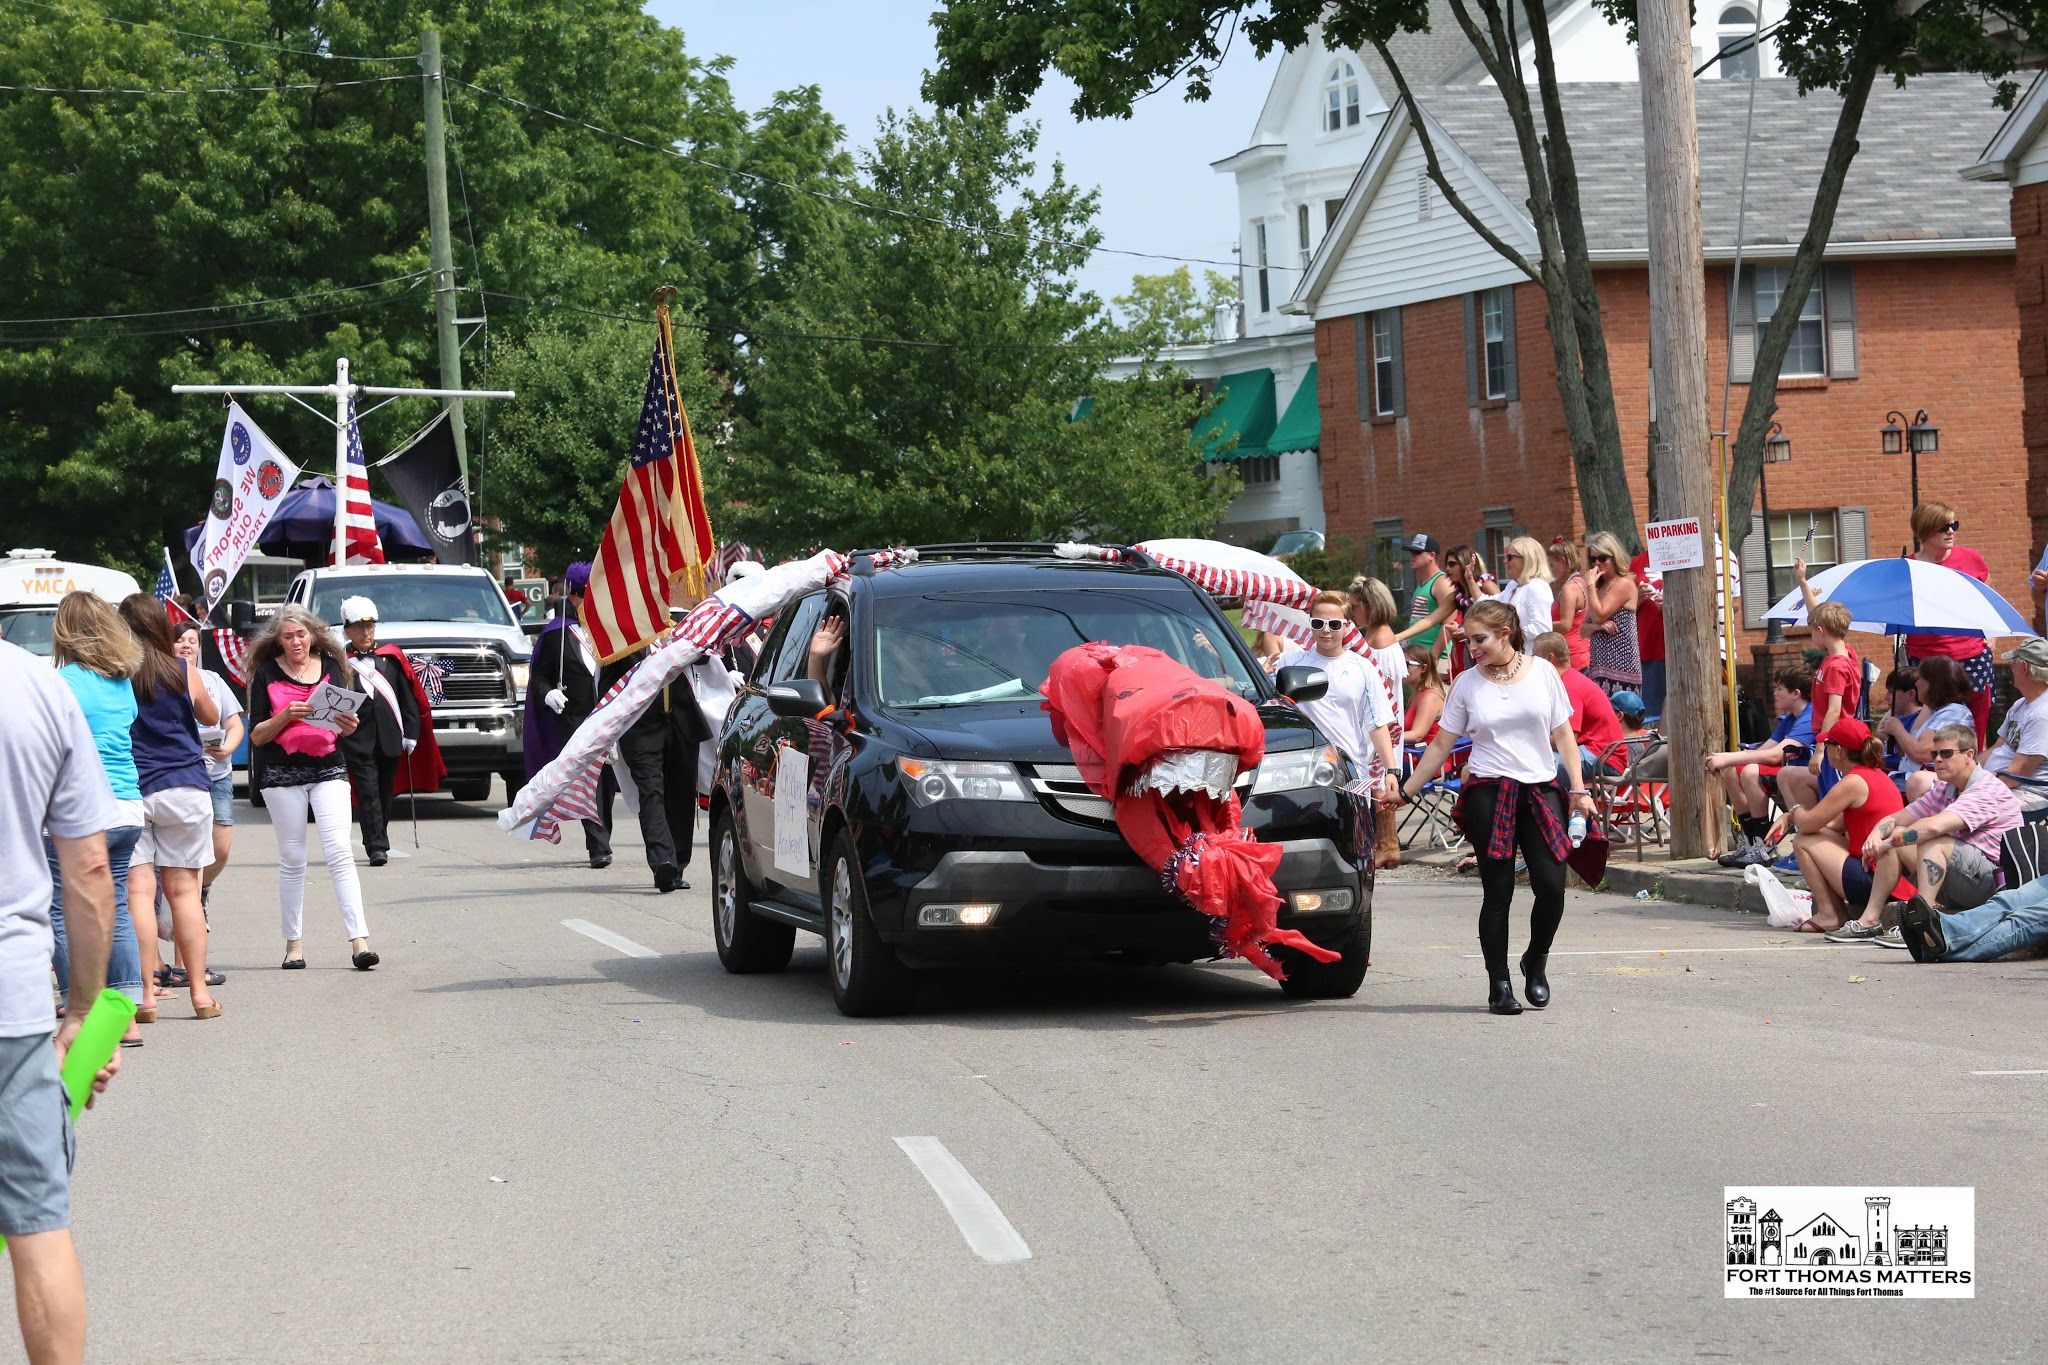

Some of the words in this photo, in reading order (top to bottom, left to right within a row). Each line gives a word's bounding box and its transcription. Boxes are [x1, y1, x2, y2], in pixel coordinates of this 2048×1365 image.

[1647, 527, 1660, 539] NO
[1661, 522, 1698, 538] PARKING
[22, 579, 77, 594] YMCA
